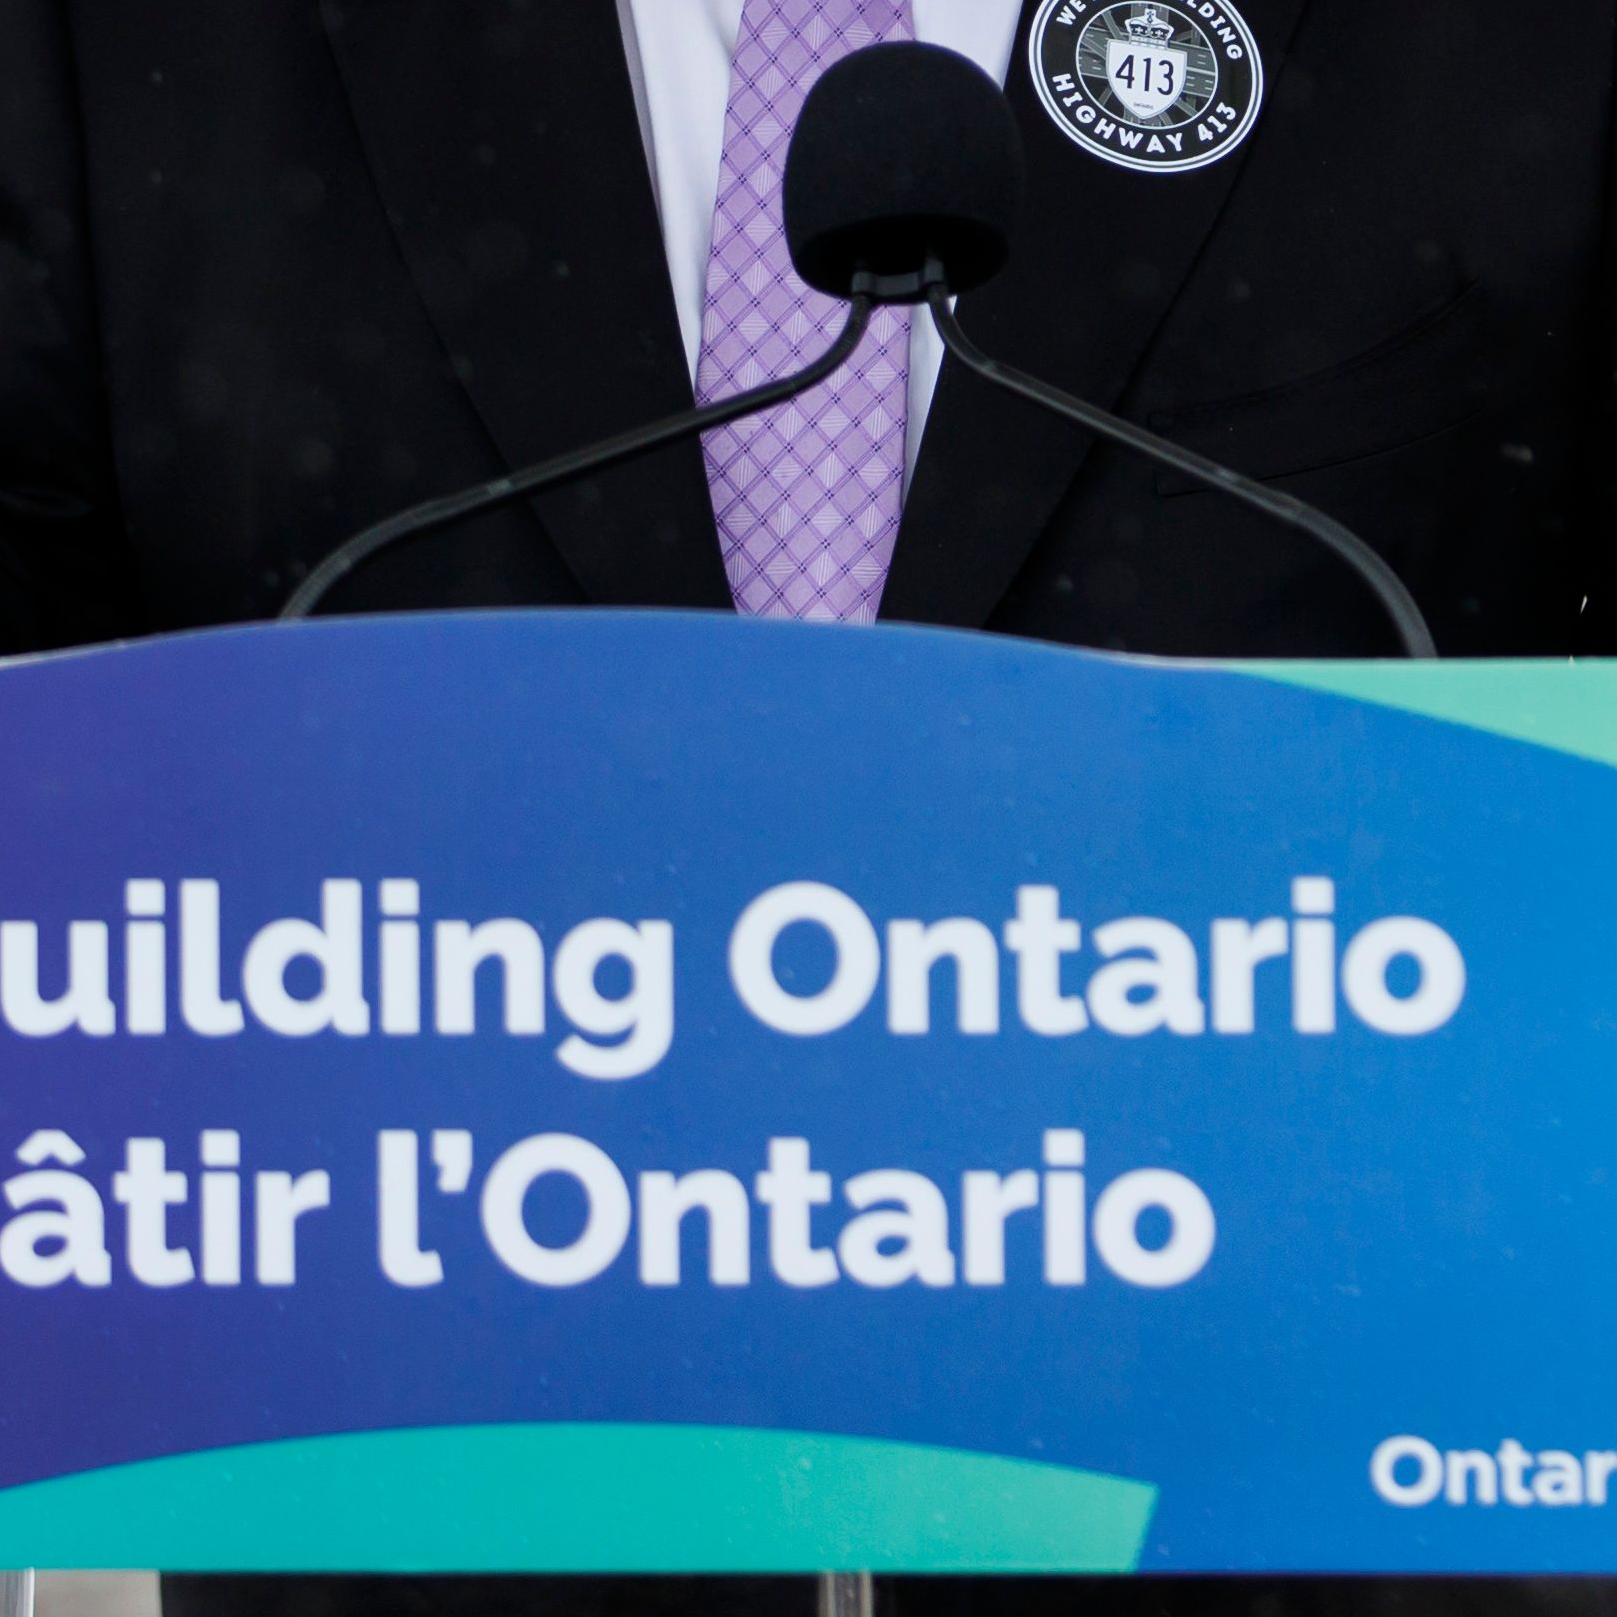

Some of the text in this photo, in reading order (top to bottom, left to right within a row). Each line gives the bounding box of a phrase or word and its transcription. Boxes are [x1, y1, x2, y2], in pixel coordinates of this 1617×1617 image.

[1052, 73, 1237, 153] HIGHWAY 413
[1115, 54, 1174, 96] 413
[728, 876, 1466, 1037] Ontario
[377, 1128, 1216, 1288] l’Ontario
